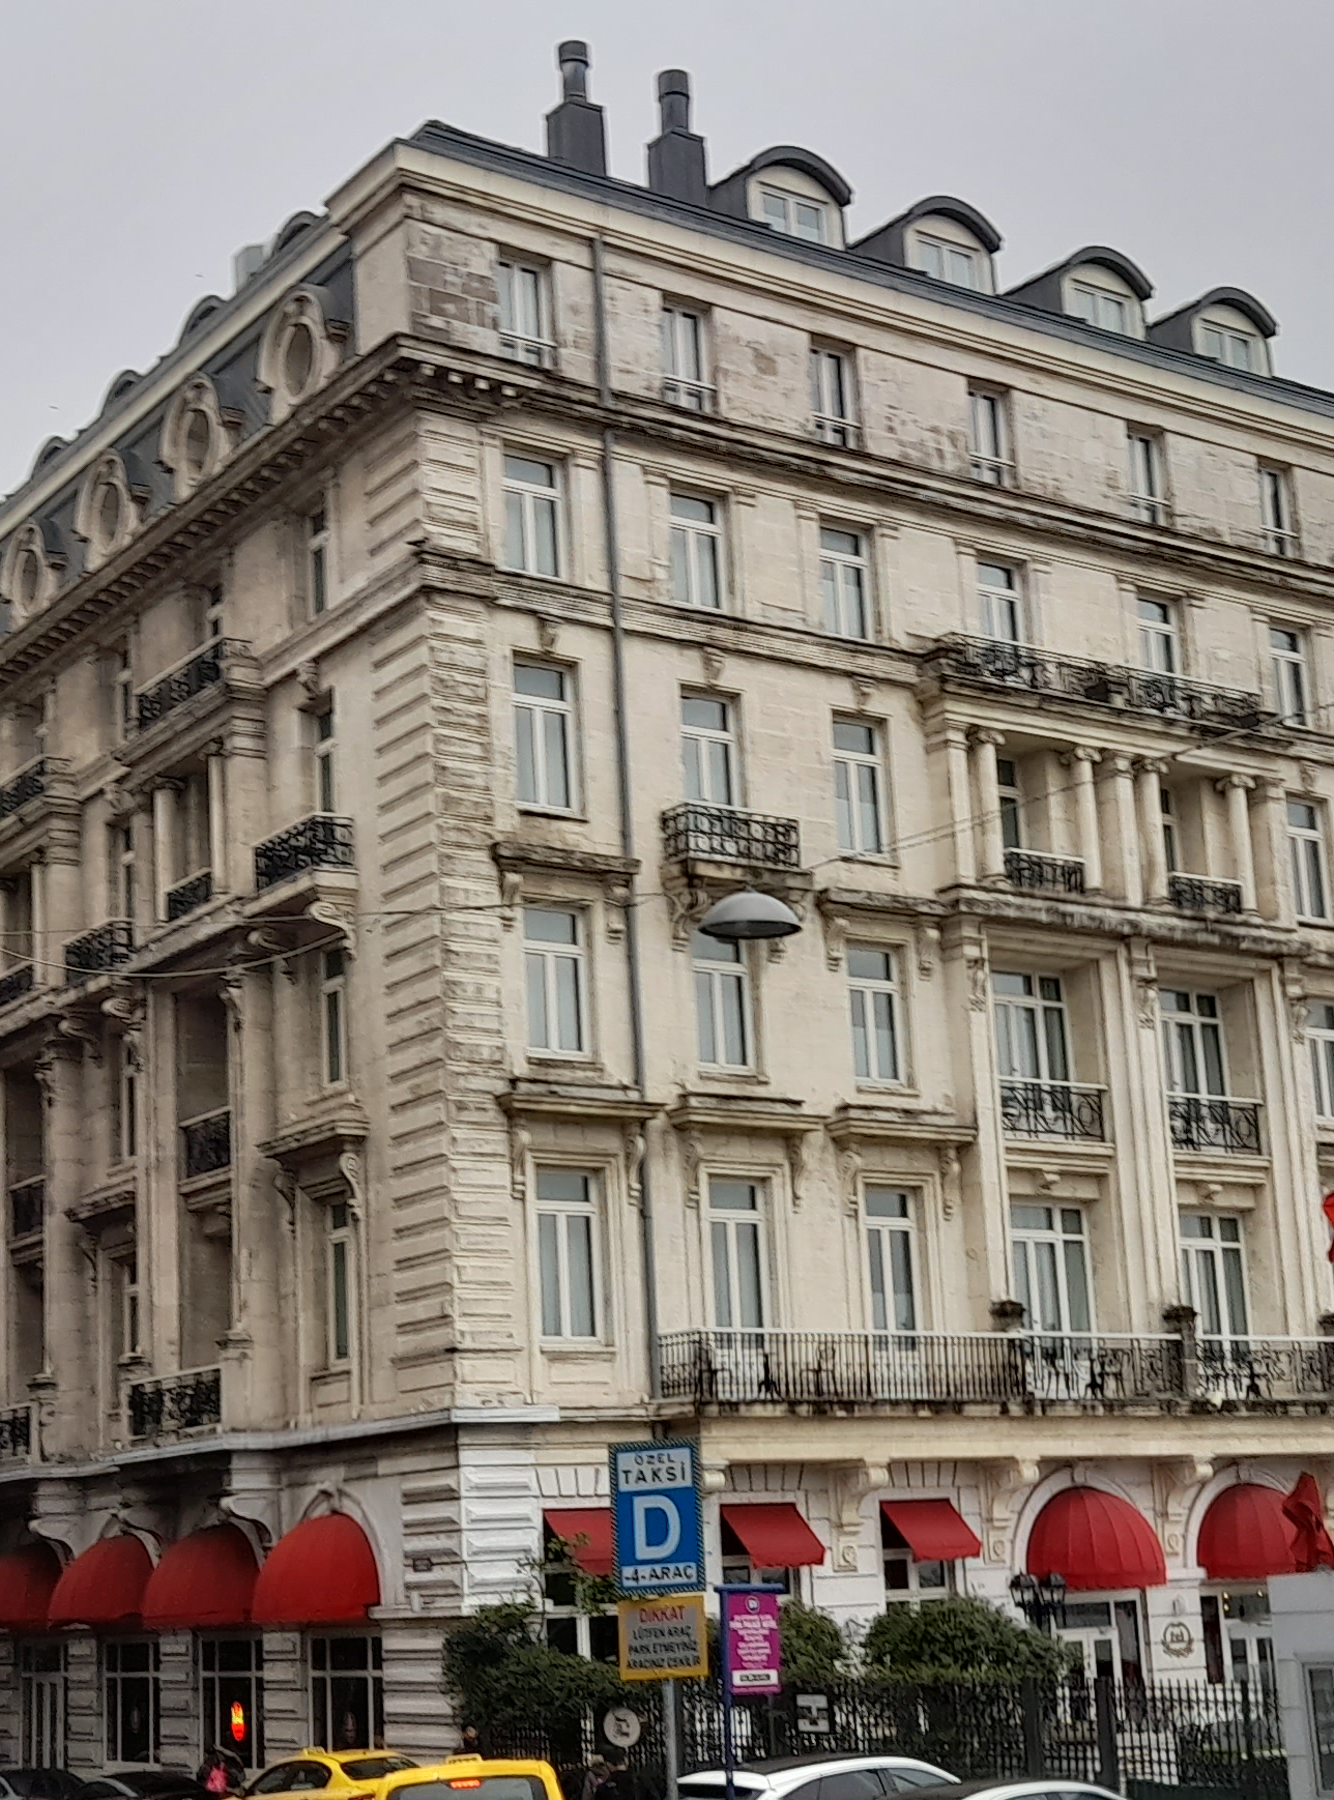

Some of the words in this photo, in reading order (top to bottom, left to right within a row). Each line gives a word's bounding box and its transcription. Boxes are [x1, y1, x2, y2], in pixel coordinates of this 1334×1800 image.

[634, 1452, 676, 1466] ÖZEL
[622, 1461, 686, 1485] TAKSİ
[632, 1494, 681, 1561] D
